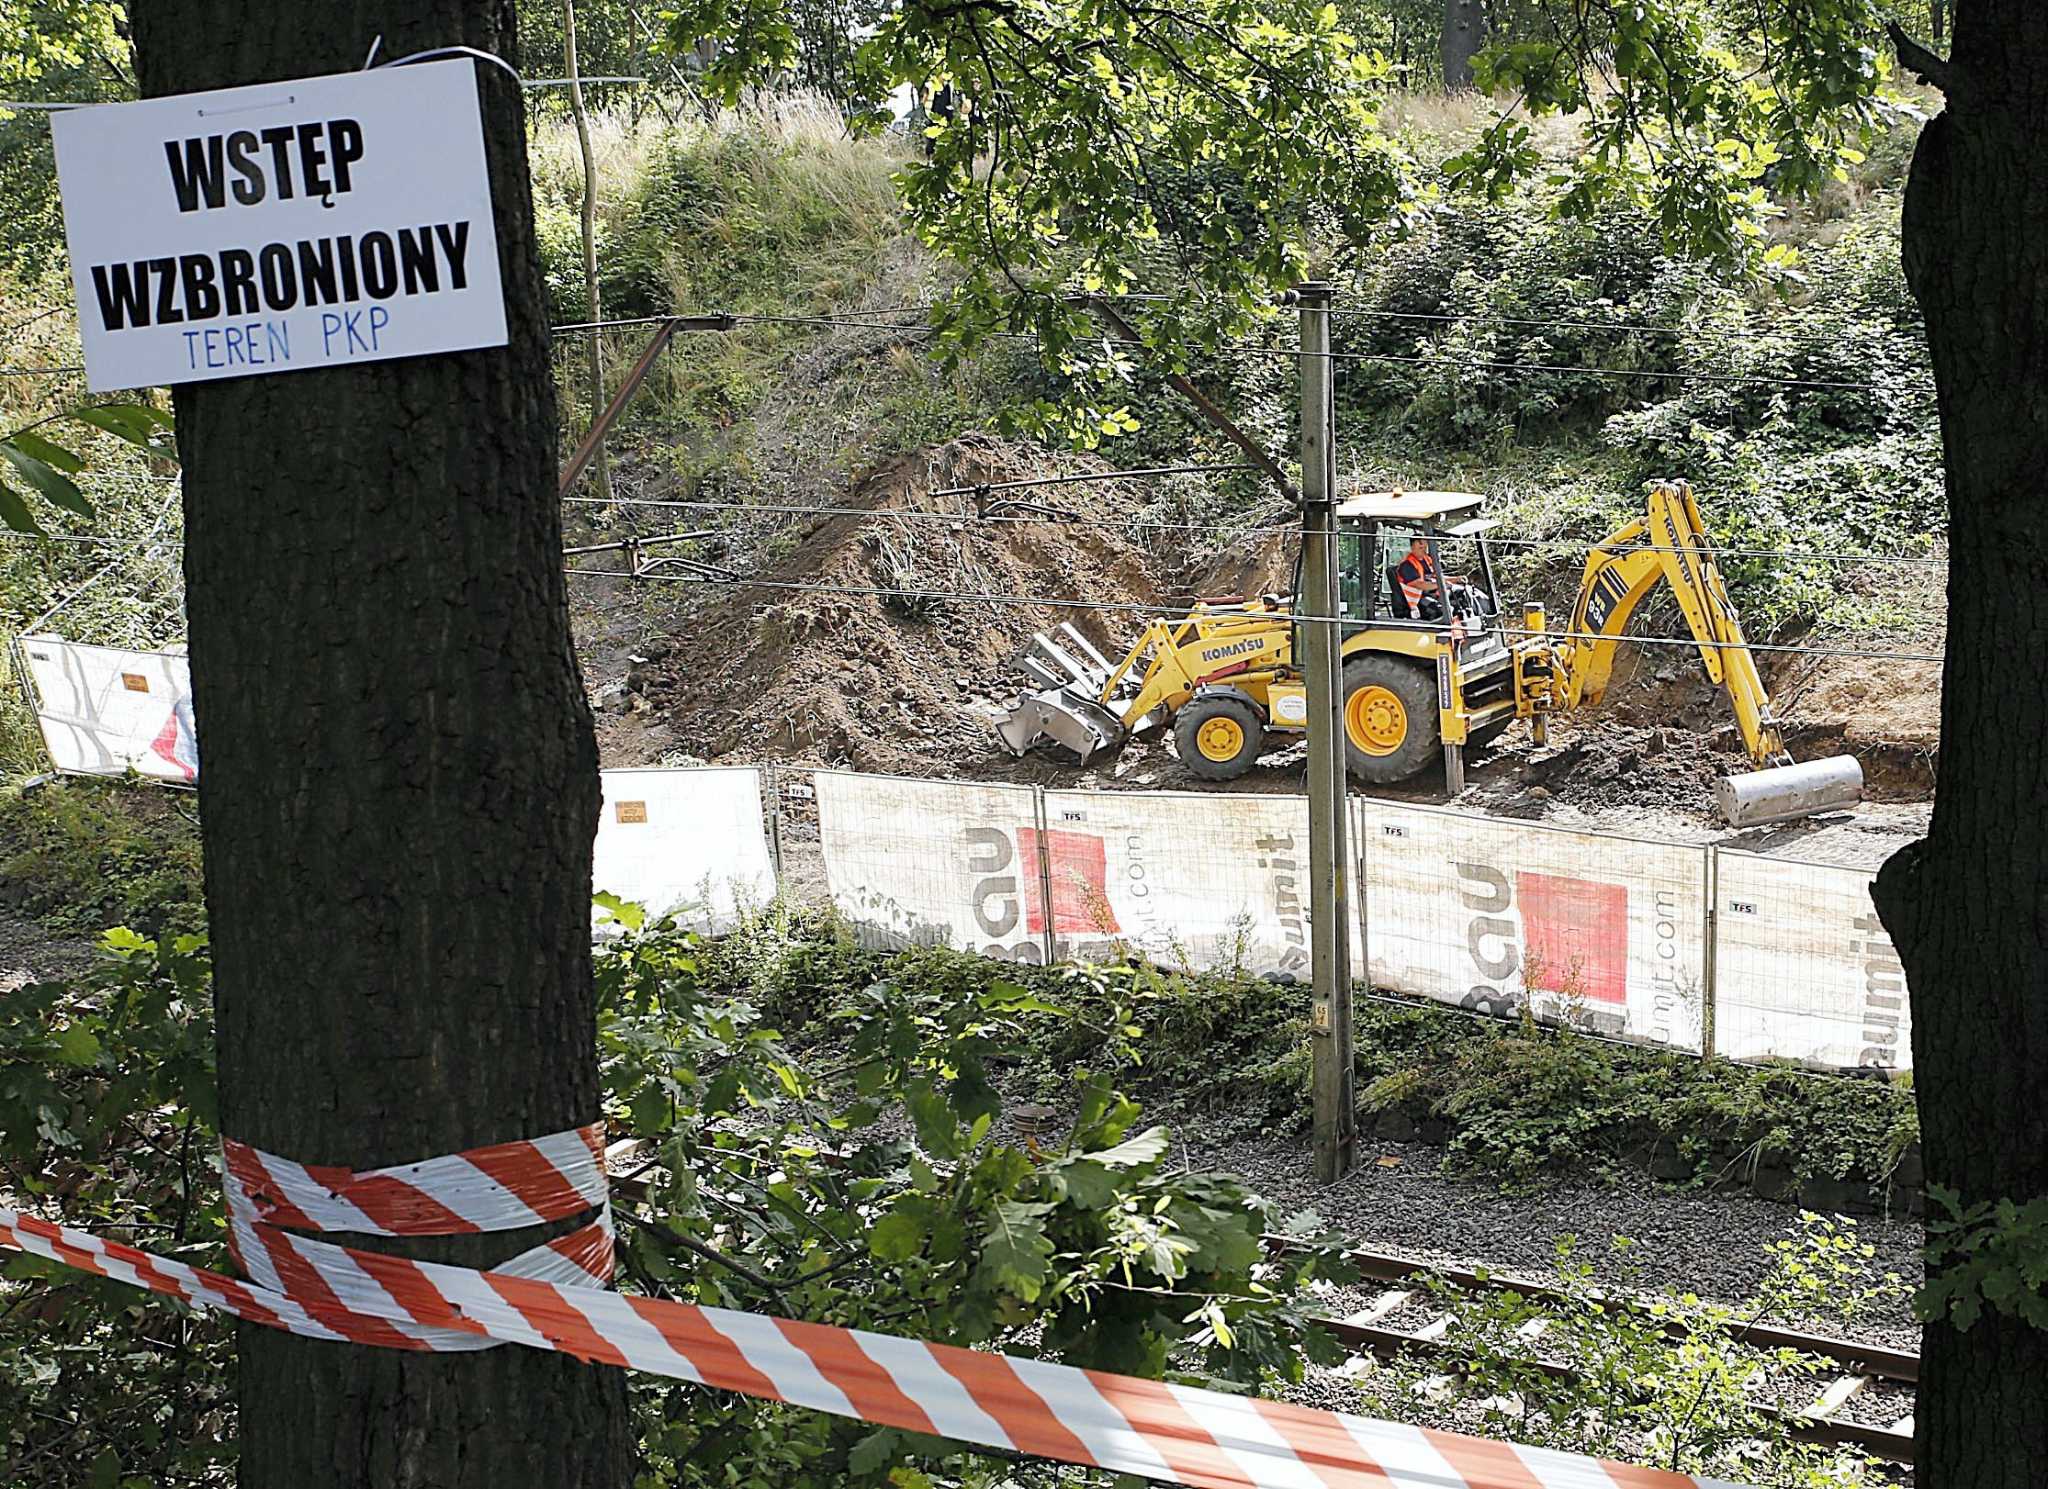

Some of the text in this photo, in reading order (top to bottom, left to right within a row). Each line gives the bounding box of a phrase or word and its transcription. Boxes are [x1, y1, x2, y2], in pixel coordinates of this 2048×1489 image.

[163, 118, 364, 213] WSTĘP
[91, 221, 470, 332] WZBRONIONY
[182, 306, 390, 369] TEREN PKP
[1202, 638, 1264, 662] KOMATSU
[1064, 813, 1081, 821] TFS
[1384, 826, 1403, 836] TFS
[1733, 903, 1752, 913] TFS
